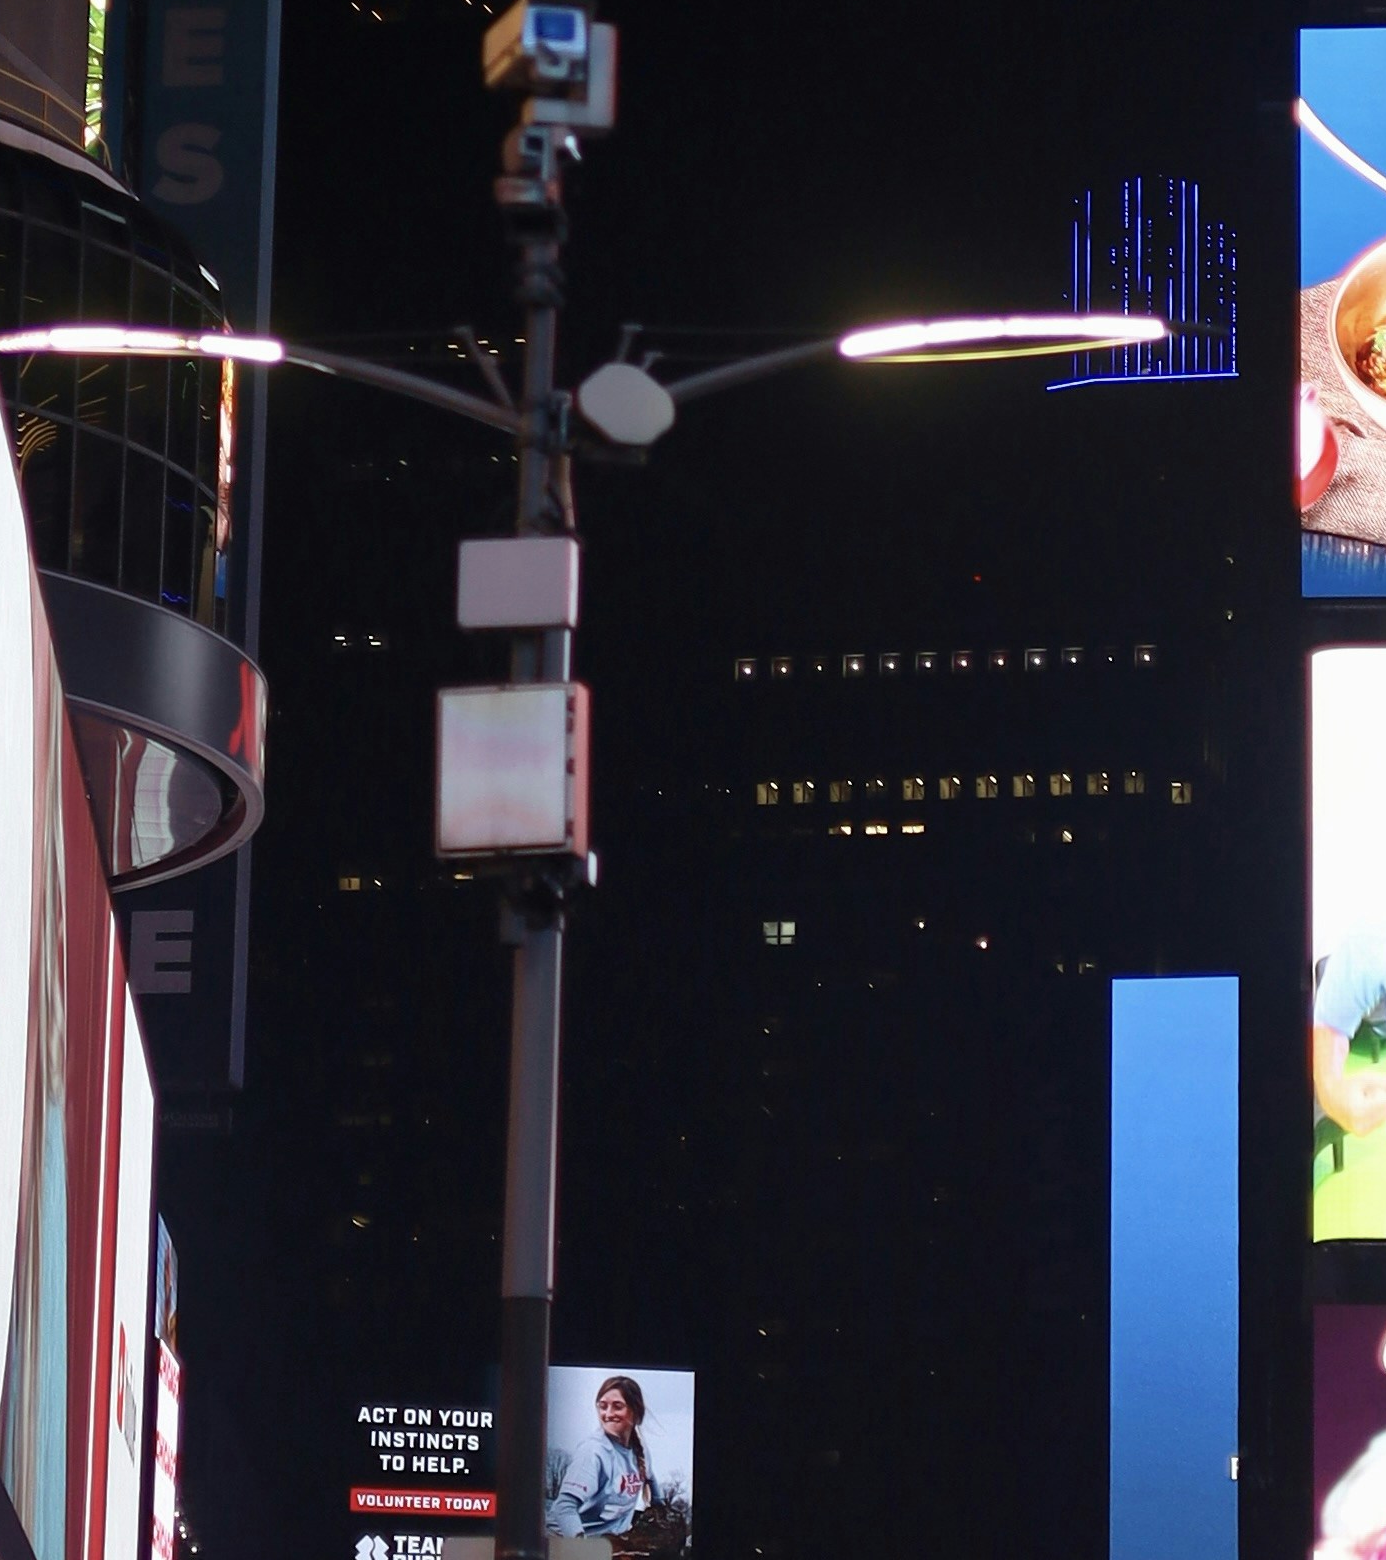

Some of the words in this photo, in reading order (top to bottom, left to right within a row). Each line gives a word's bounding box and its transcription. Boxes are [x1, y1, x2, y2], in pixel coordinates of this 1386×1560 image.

[357, 1406, 398, 1425] ACT
[403, 1408, 432, 1426] ON
[438, 1410, 494, 1429] YOUR
[370, 1430, 480, 1451] INSTINCTS
[379, 1454, 406, 1471] TO
[412, 1455, 470, 1475] HELP.
[356, 1493, 441, 1509] VOLUNTEER
[444, 1497, 491, 1512] TODAY
